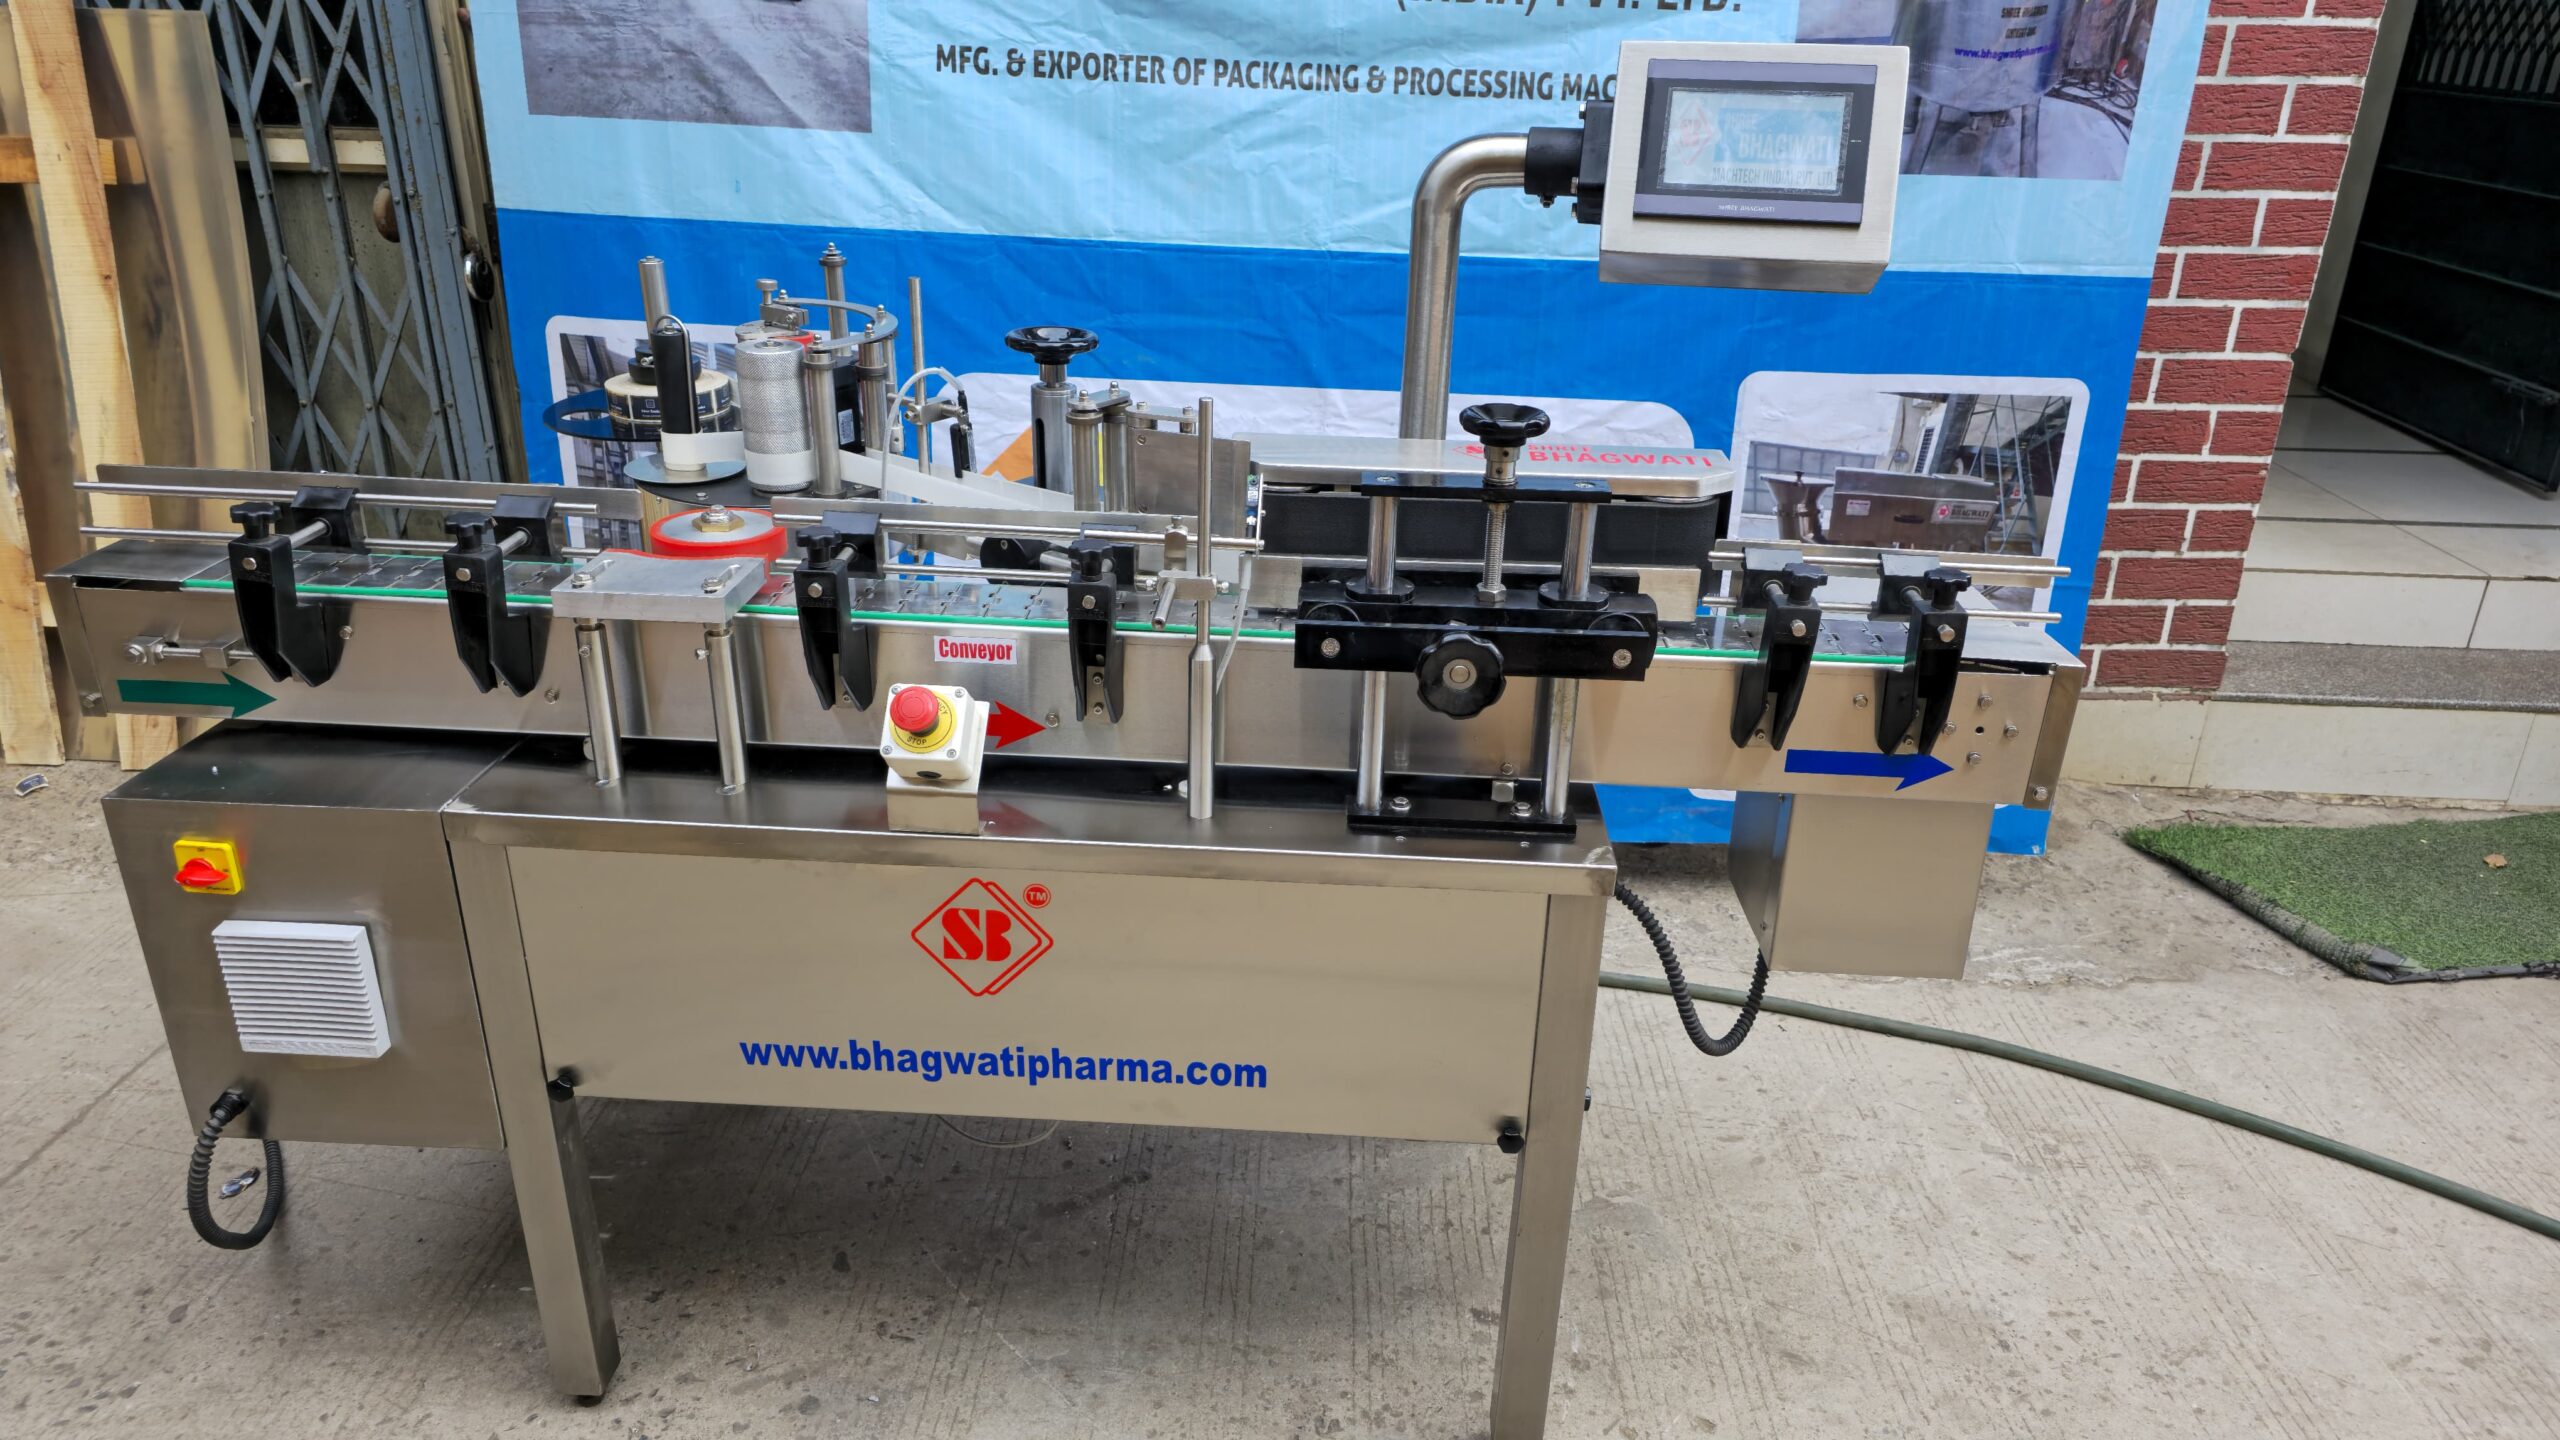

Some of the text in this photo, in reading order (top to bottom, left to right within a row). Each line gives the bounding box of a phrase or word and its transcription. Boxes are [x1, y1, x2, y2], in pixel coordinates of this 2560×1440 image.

[936, 44, 998, 76] MFG.
[1006, 48, 1026, 77] &
[1033, 50, 1165, 84] EXPORTER
[1173, 57, 1206, 86] OF
[1213, 58, 1358, 93] PACKAGING
[1366, 65, 1386, 93] &
[1393, 66, 1552, 101] PROCESSING
[1528, 450, 1713, 468] BHAGWATI
[938, 638, 1012, 661] Conveyor
[907, 736, 927, 746] STOP
[1028, 891, 1047, 901] TM
[941, 907, 1012, 962] SB
[739, 1039, 1268, 1089] www.bhagwatipharma.com
